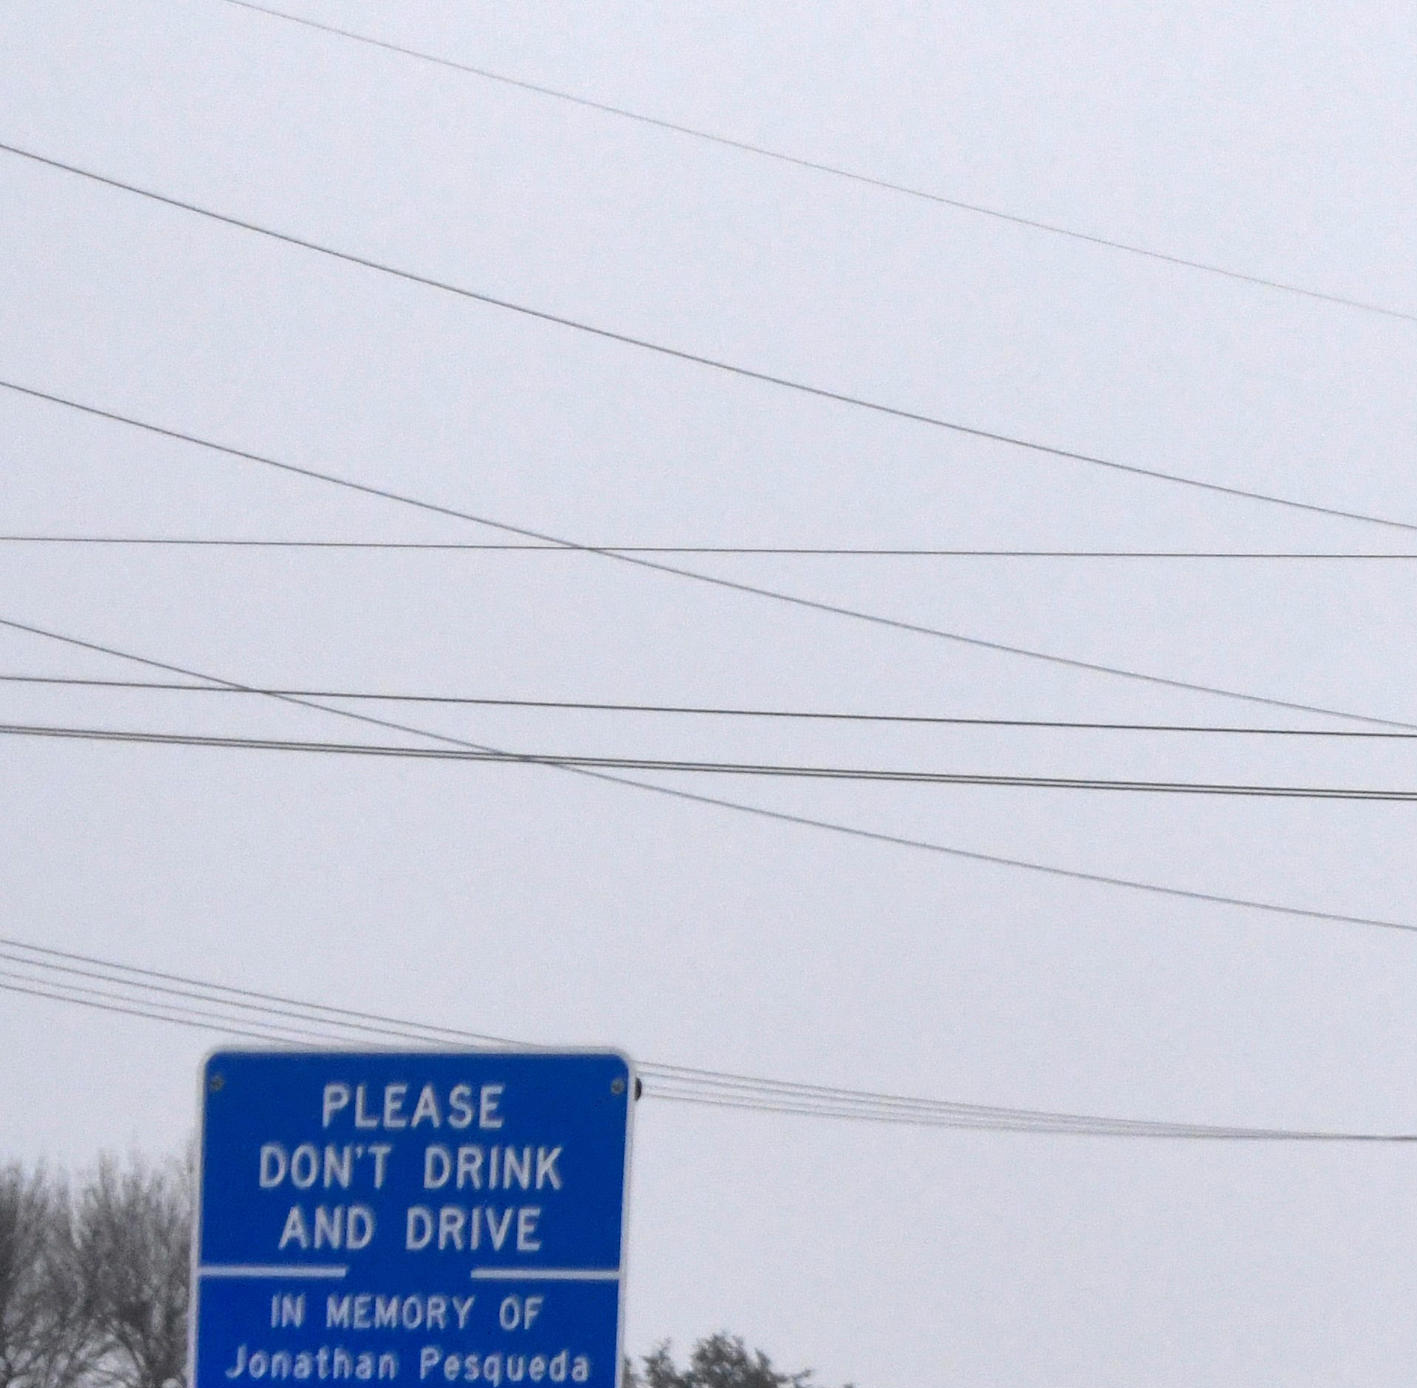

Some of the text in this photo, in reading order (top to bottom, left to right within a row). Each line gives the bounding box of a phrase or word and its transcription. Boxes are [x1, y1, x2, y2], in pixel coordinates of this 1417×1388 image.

[322, 1083, 504, 1129] PLEASE
[259, 1145, 562, 1190] DON'T DRINK
[278, 1206, 541, 1251] AND DRIVE
[271, 1294, 544, 1331] IN MEMORY OF
[225, 1345, 590, 1388] Jonathan Pesqueda
